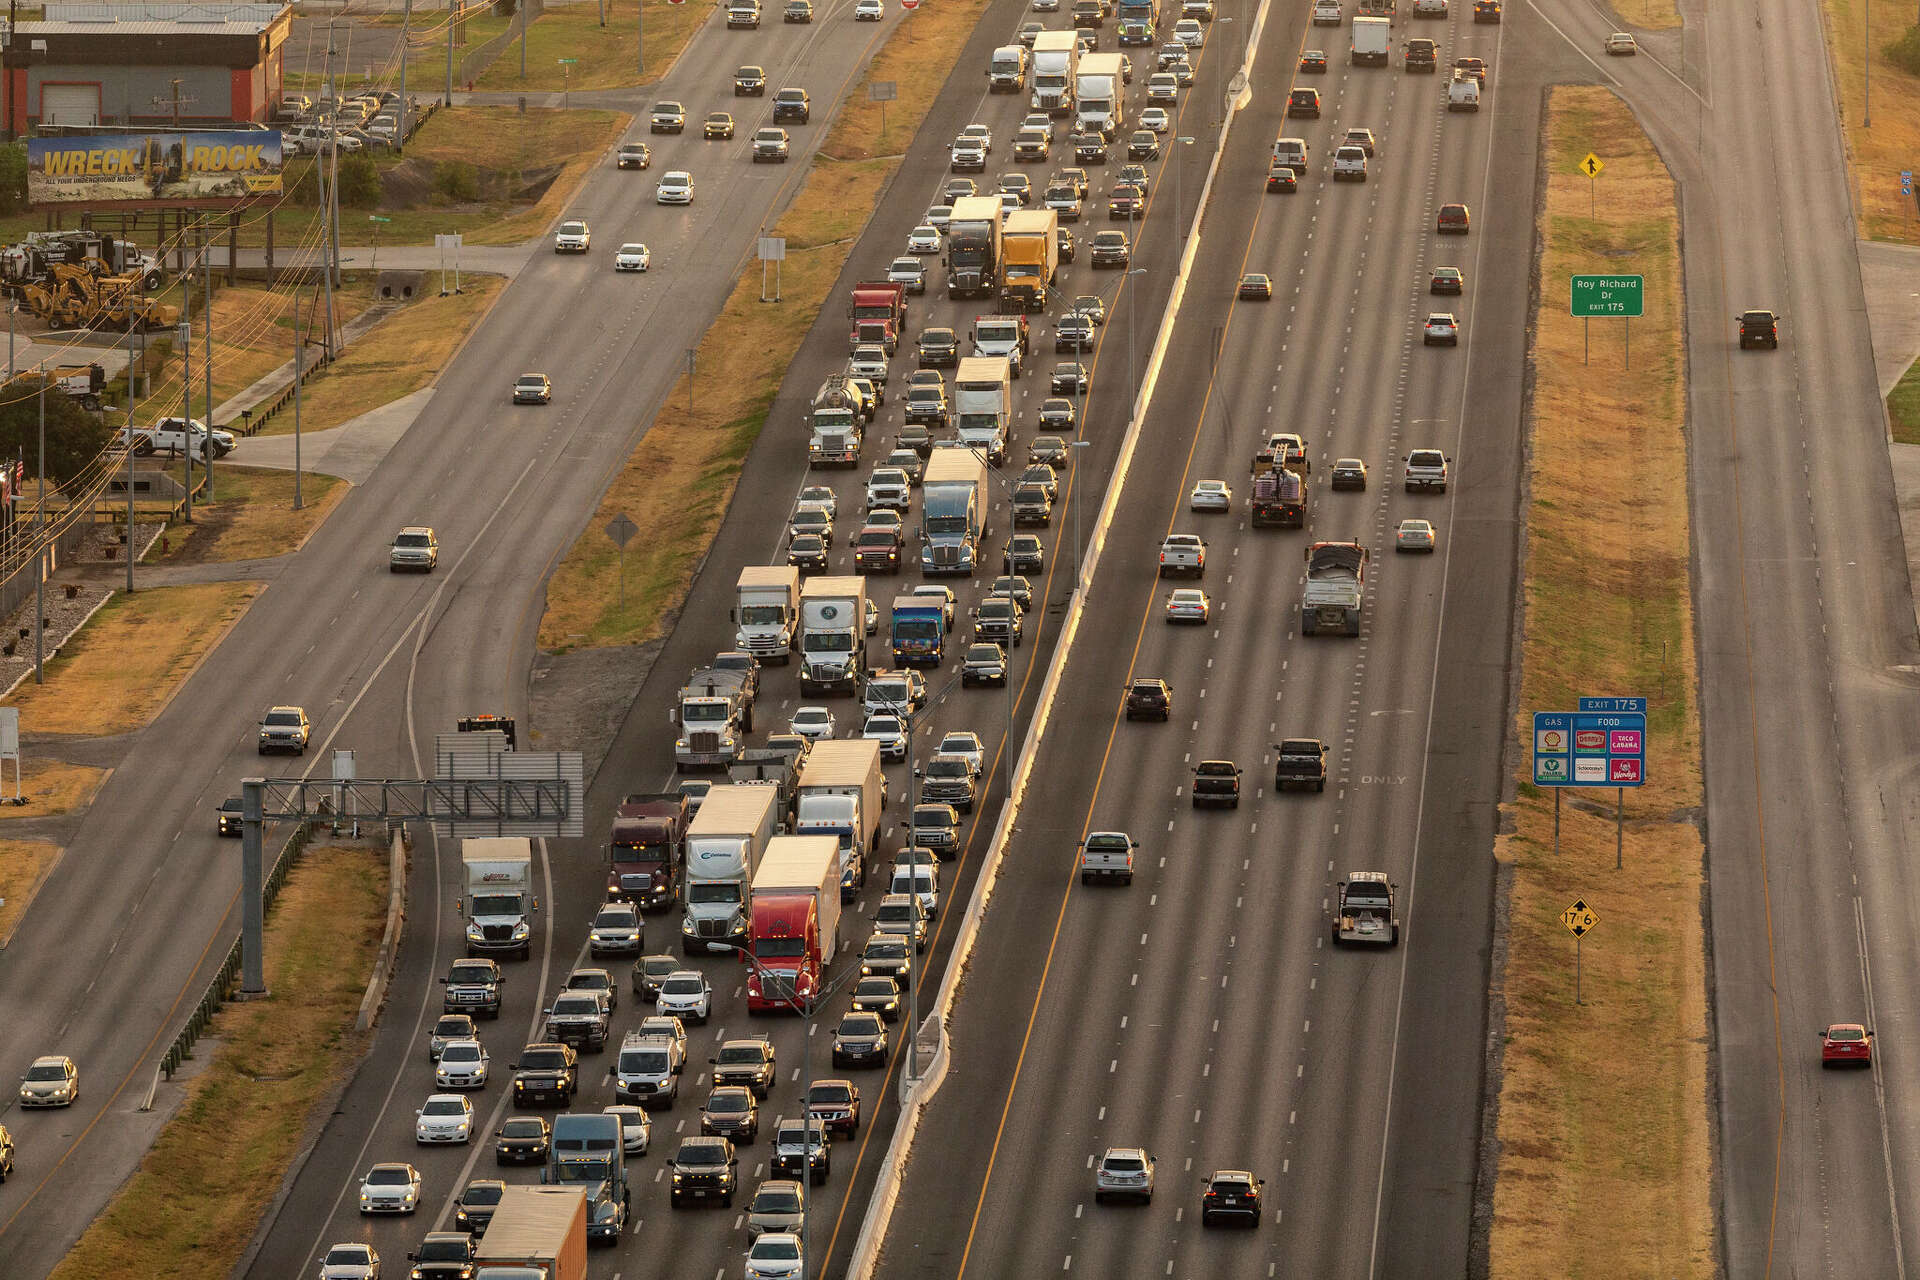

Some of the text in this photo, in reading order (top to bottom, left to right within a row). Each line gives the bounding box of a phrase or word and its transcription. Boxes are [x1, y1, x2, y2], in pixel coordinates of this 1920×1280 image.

[44, 144, 265, 176] WRECK ROCK
[1577, 280, 1637, 290] Roy Richard
[1601, 291, 1612, 299] Dr
[1607, 302, 1624, 311] 175
[1588, 700, 1637, 710] EXIT 175
[1361, 776, 1407, 784] ONLY
[1564, 912, 1577, 924] 17
[1584, 913, 1592, 925] 6
